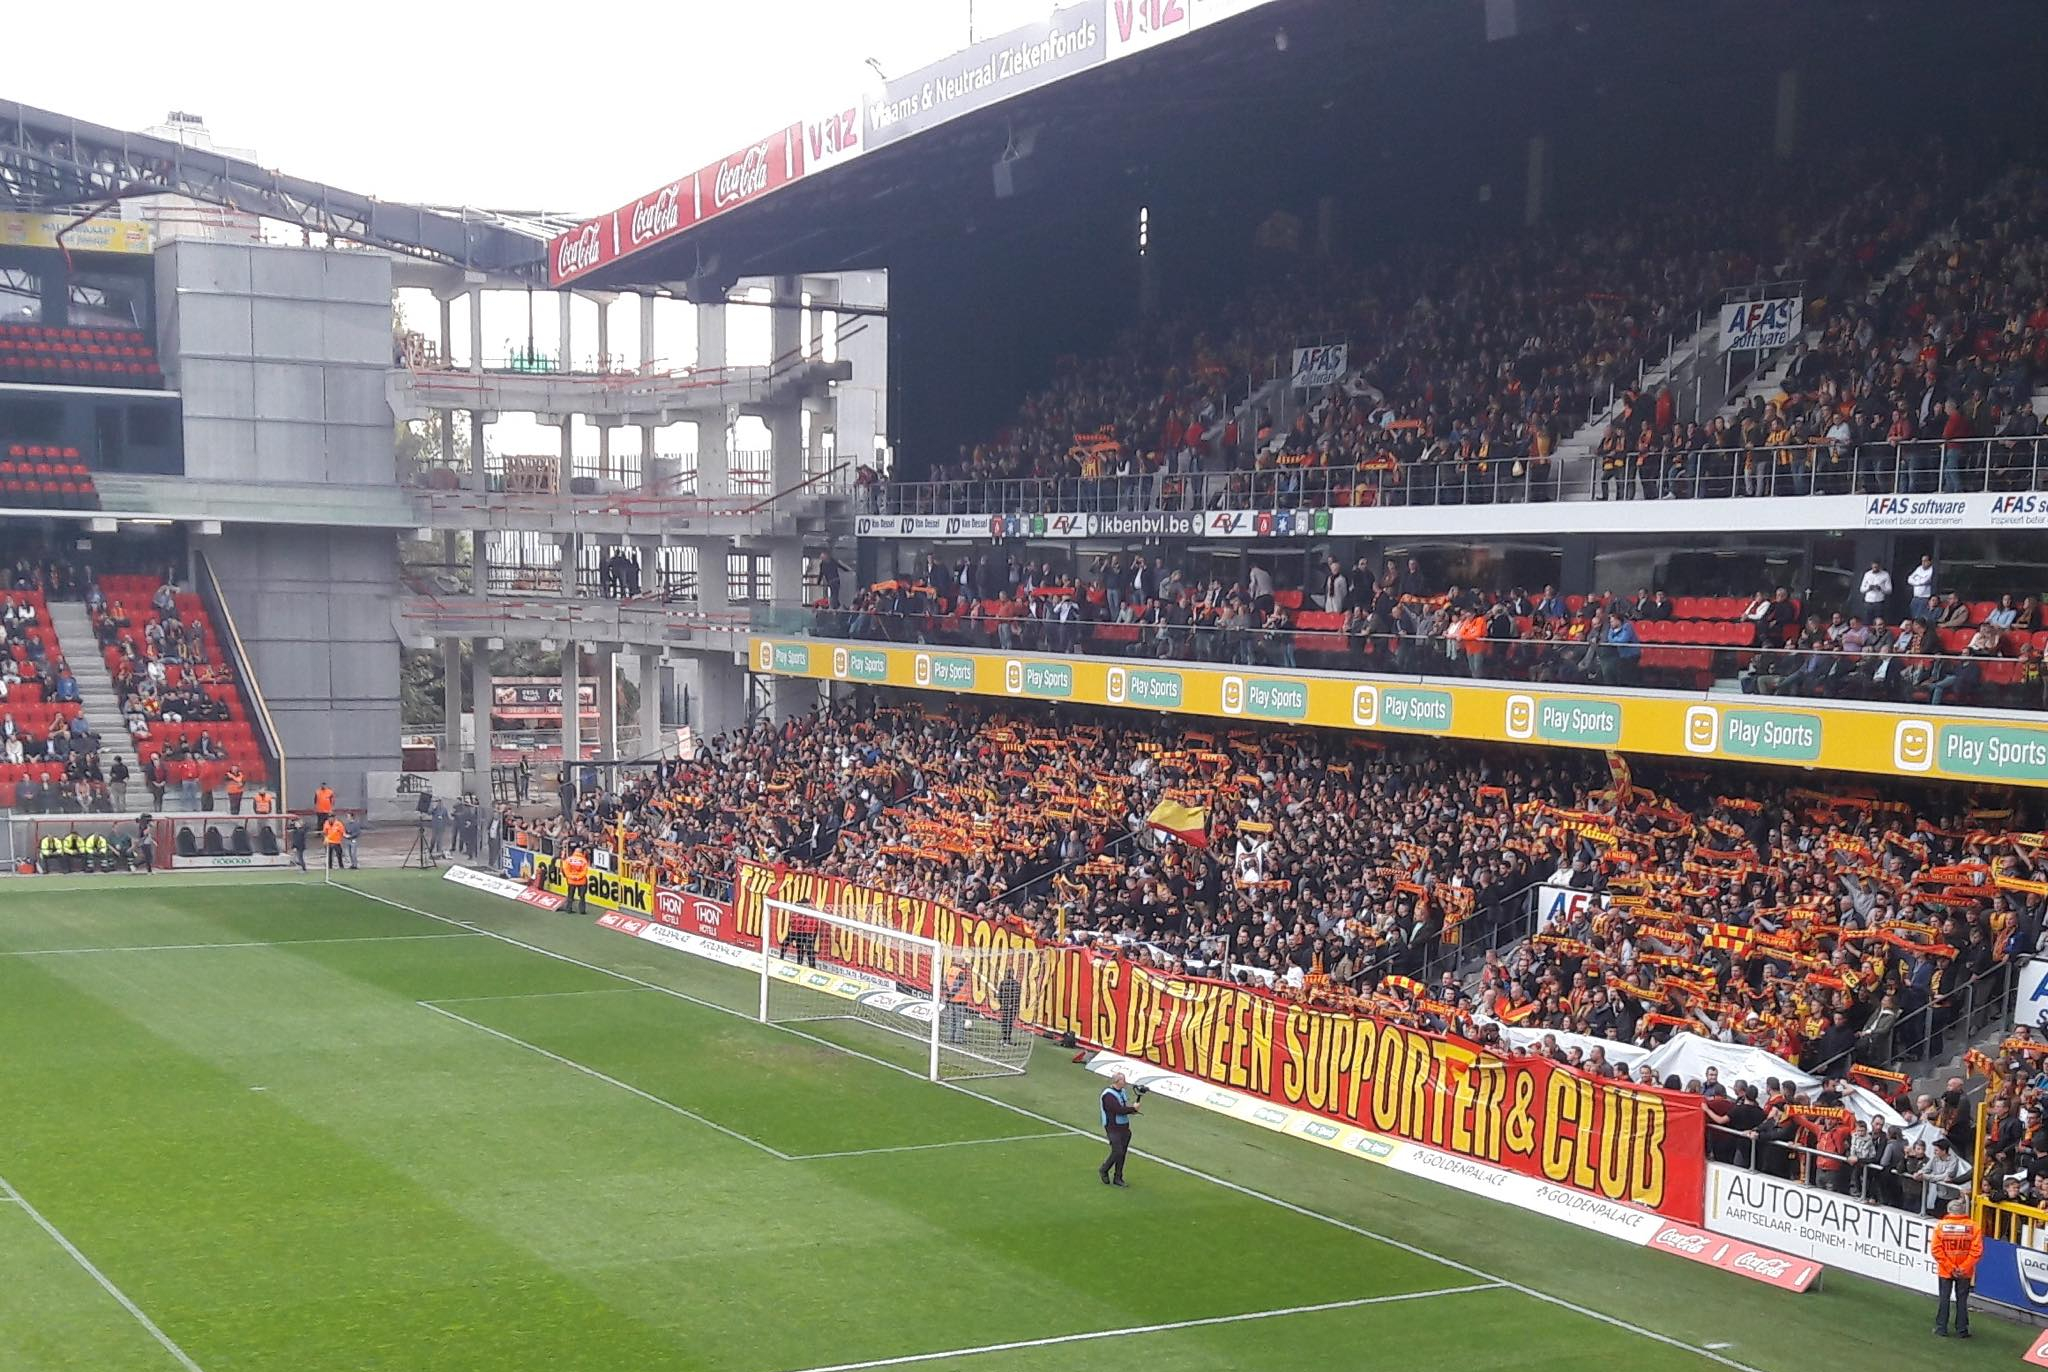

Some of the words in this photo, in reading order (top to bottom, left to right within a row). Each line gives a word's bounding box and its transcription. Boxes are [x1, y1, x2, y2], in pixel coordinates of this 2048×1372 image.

[921, 82, 934, 111] &
[935, 54, 997, 103] Neutraal
[999, 19, 1097, 80] Ziekenfonds
[1728, 300, 1795, 333] AFAS
[1868, 497, 1910, 515] AFAS
[1911, 499, 1966, 515] software
[1991, 495, 2037, 513] AFAS
[1100, 514, 1190, 533] ikbenbvl.be
[775, 649, 788, 665] Play
[788, 650, 806, 666] Sports
[851, 656, 865, 673] Play
[865, 657, 885, 674] Sports
[934, 662, 949, 680] Play
[949, 664, 971, 681] Sports
[1026, 668, 1043, 687] Play
[1044, 670, 1069, 688] Sports
[1131, 676, 1149, 695] Play
[1150, 678, 1177, 698] Sports
[1249, 685, 1270, 705] Play
[1271, 688, 1302, 708] Sports
[1385, 695, 1410, 718] Play
[1412, 697, 1446, 721] Sports
[1542, 707, 1573, 735] Play
[1574, 709, 1614, 737] Sports
[1728, 719, 1762, 748] Play
[1764, 721, 1814, 750] Sports
[1947, 734, 1984, 765] Play
[1988, 736, 2046, 767] Sports
[656, 891, 685, 915] THON
[692, 901, 723, 927] THON
[831, 880, 929, 983] LOYALTY
[934, 902, 957, 988] IN
[962, 918, 1083, 1035] FOOTBALL
[1089, 957, 1121, 1050] IS
[1126, 965, 1277, 1096] BETWEEN
[1282, 1002, 1507, 1163] SUPPORTER
[1505, 1068, 1536, 1157] &
[1541, 1066, 1667, 1209] CLUB
[1793, 1104, 1844, 1119] MALINWA
[1423, 1152, 1508, 1188] GOLDENPALACE
[1548, 1189, 1645, 1229] GOLDENPALACE
[1726, 1207, 1791, 1234] AARTSELAAR
[1799, 1226, 1846, 1250] BORNEM
[1854, 1243, 1915, 1269] MECHELEN
[1924, 1259, 1938, 1275] TE
